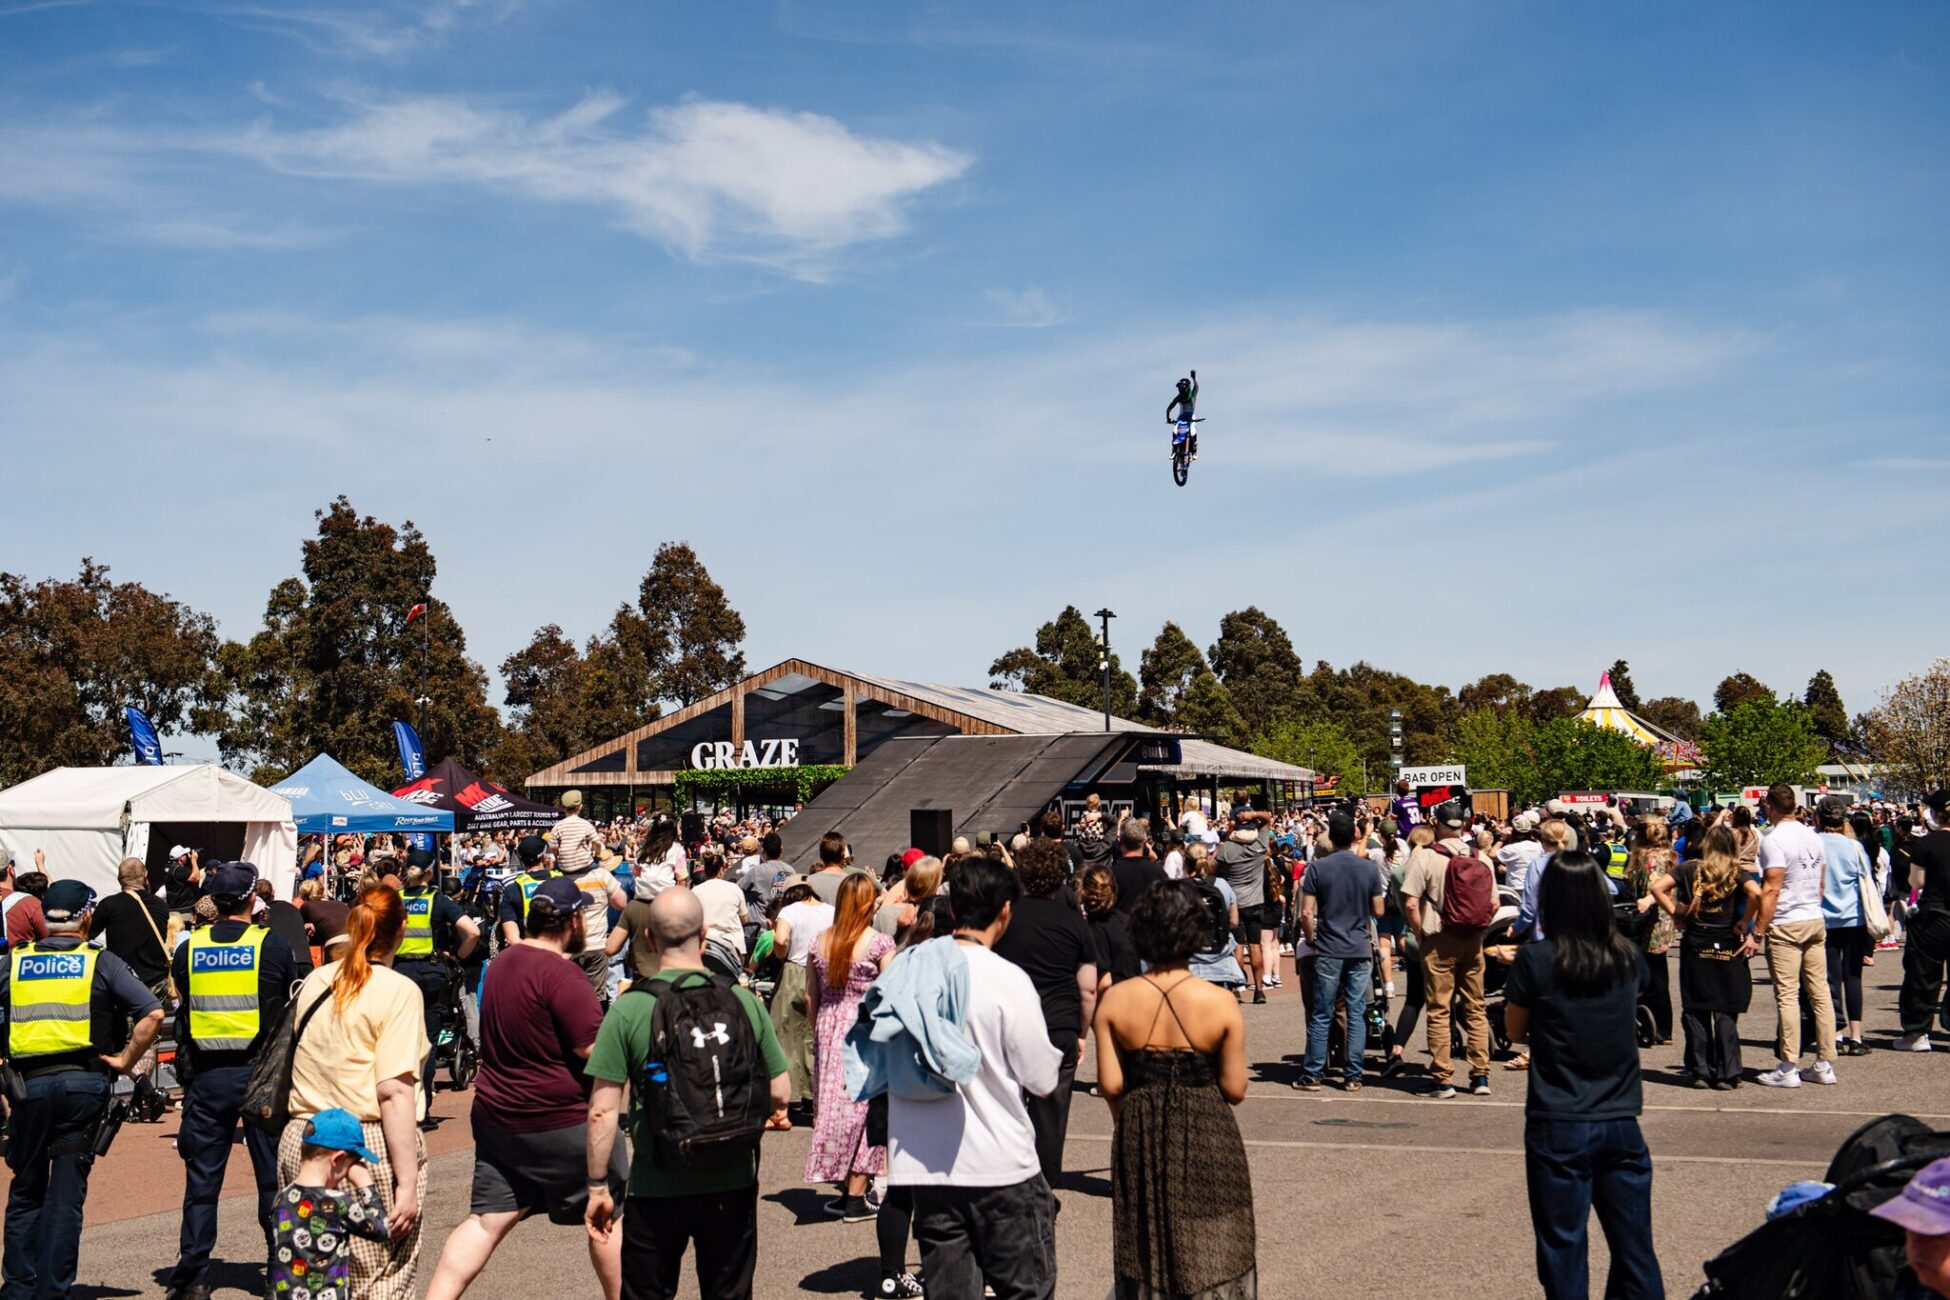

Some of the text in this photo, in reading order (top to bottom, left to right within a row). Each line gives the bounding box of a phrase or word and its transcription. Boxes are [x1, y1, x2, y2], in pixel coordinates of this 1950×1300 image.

[691, 739, 799, 770] GRAZE
[1404, 771, 1461, 783] BAR OPEN
[510, 819, 527, 827] PARTS
[20, 958, 82, 975] Police
[193, 950, 252, 967] Police
